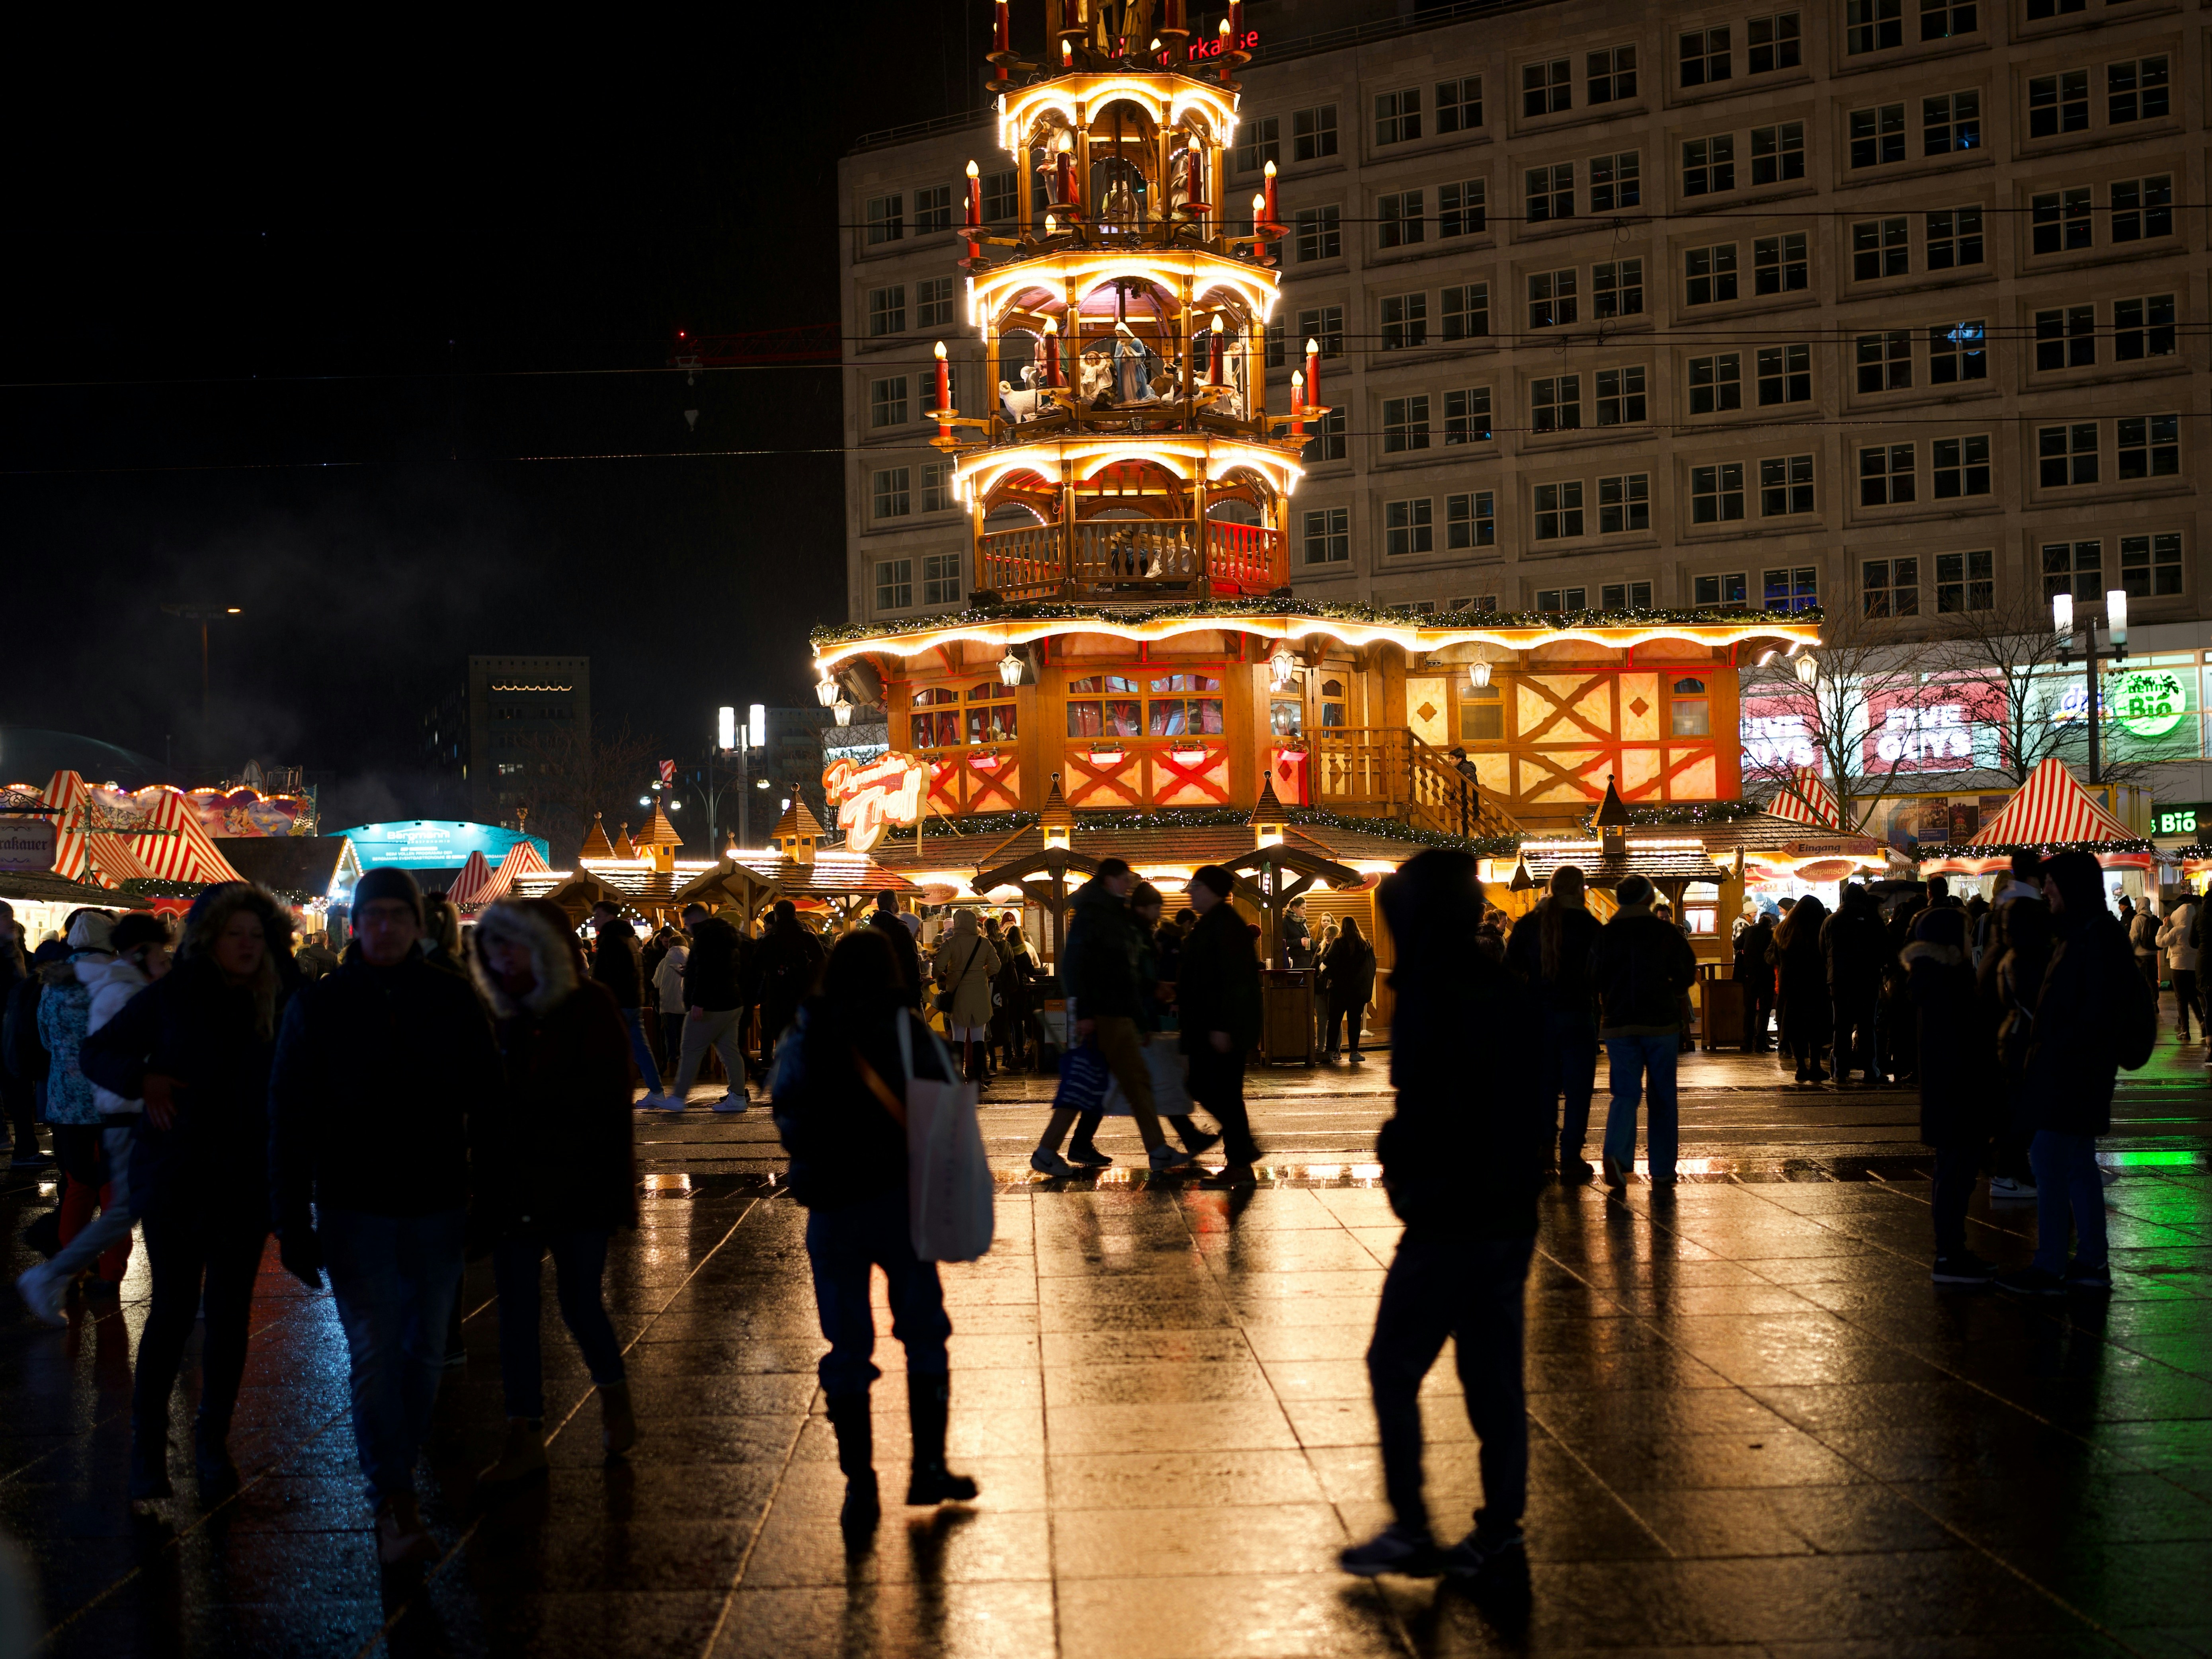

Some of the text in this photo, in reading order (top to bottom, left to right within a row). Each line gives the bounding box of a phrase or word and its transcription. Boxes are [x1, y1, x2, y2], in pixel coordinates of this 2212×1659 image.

[1886, 704, 1961, 731] FIVE
[2129, 694, 2172, 719] Bio
[1878, 732, 1971, 761] GUYS
[843, 767, 922, 851] Treff
[2161, 811, 2196, 833] Bio
[1798, 843, 1841, 853] Eingang
[1802, 864, 1846, 878] Eierpunsch
